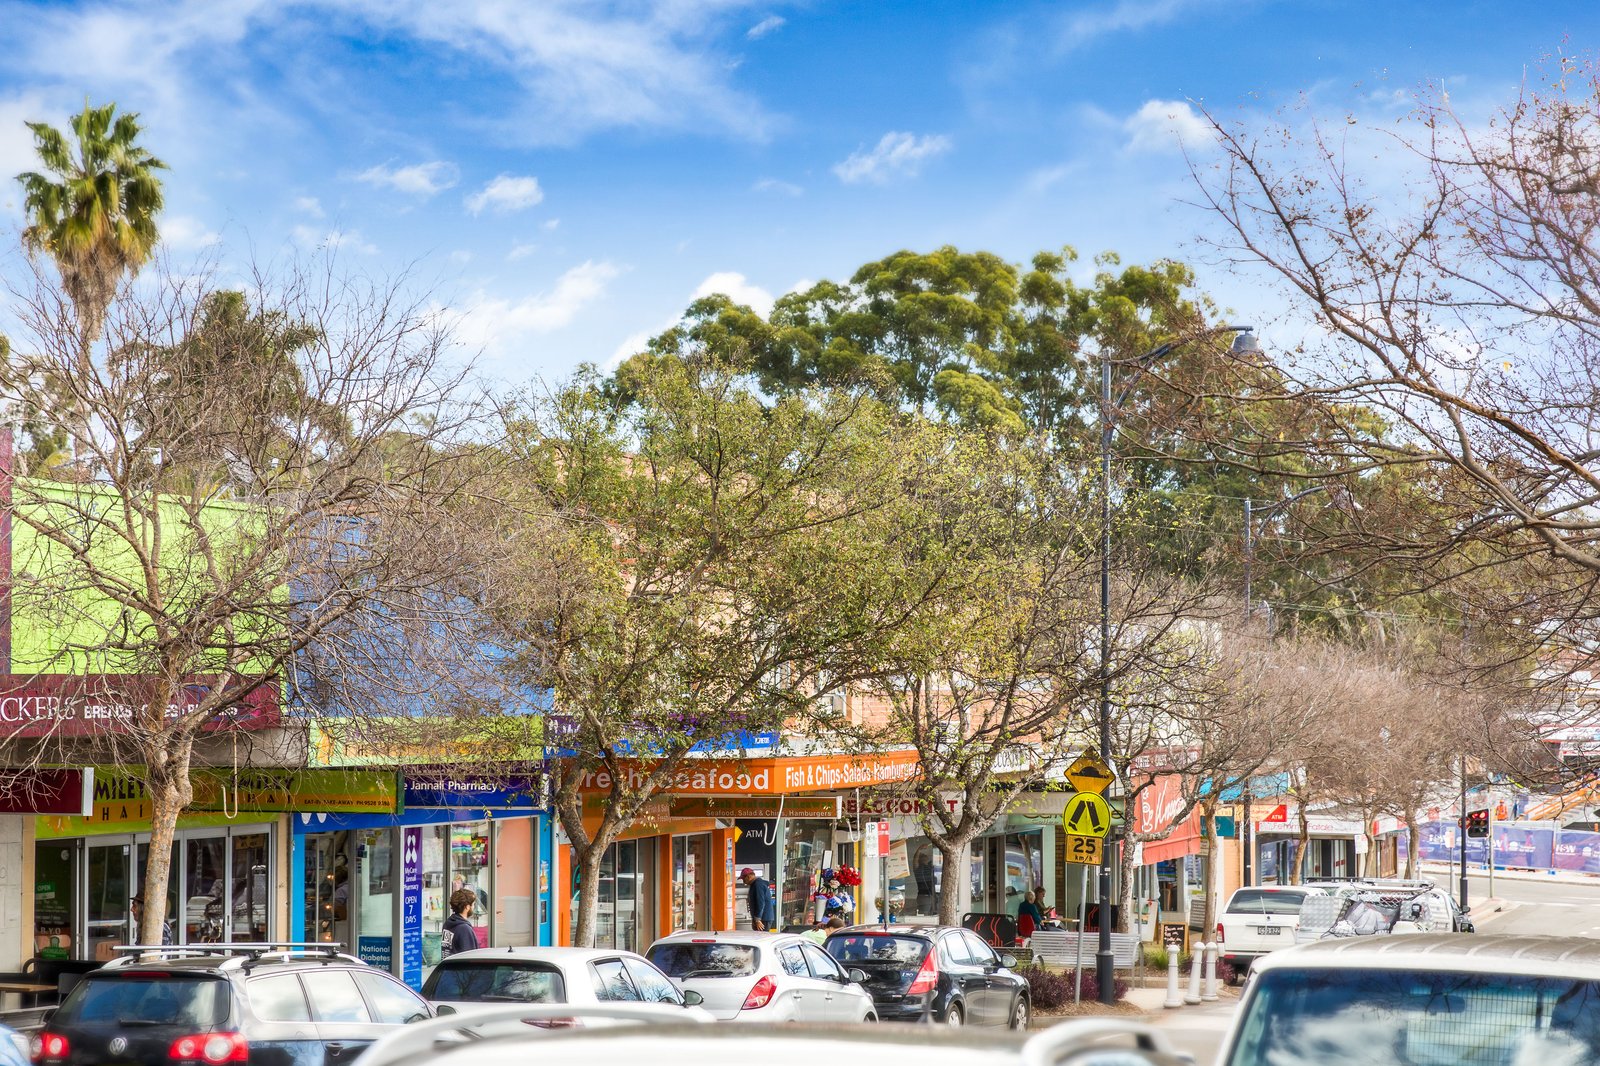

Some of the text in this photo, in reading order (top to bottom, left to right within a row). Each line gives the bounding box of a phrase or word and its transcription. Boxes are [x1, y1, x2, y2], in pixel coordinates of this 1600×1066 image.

[0, 696, 76, 721] CKERS
[785, 765, 805, 788] Fish
[807, 764, 814, 785] &
[410, 780, 445, 790] Jannali
[448, 780, 498, 792] Pharmacy
[706, 809, 736, 817] Seafood,
[765, 809, 788, 817] Chis,
[789, 810, 832, 818] Hamburgers
[746, 829, 763, 838] ATM
[1073, 837, 1096, 855] 25
[1075, 855, 1093, 863] km/h
[405, 895, 418, 904] OPEN
[408, 904, 413, 915] 7
[405, 914, 417, 924] DAYS
[360, 945, 391, 953] National
[360, 954, 391, 962] Diabetes
